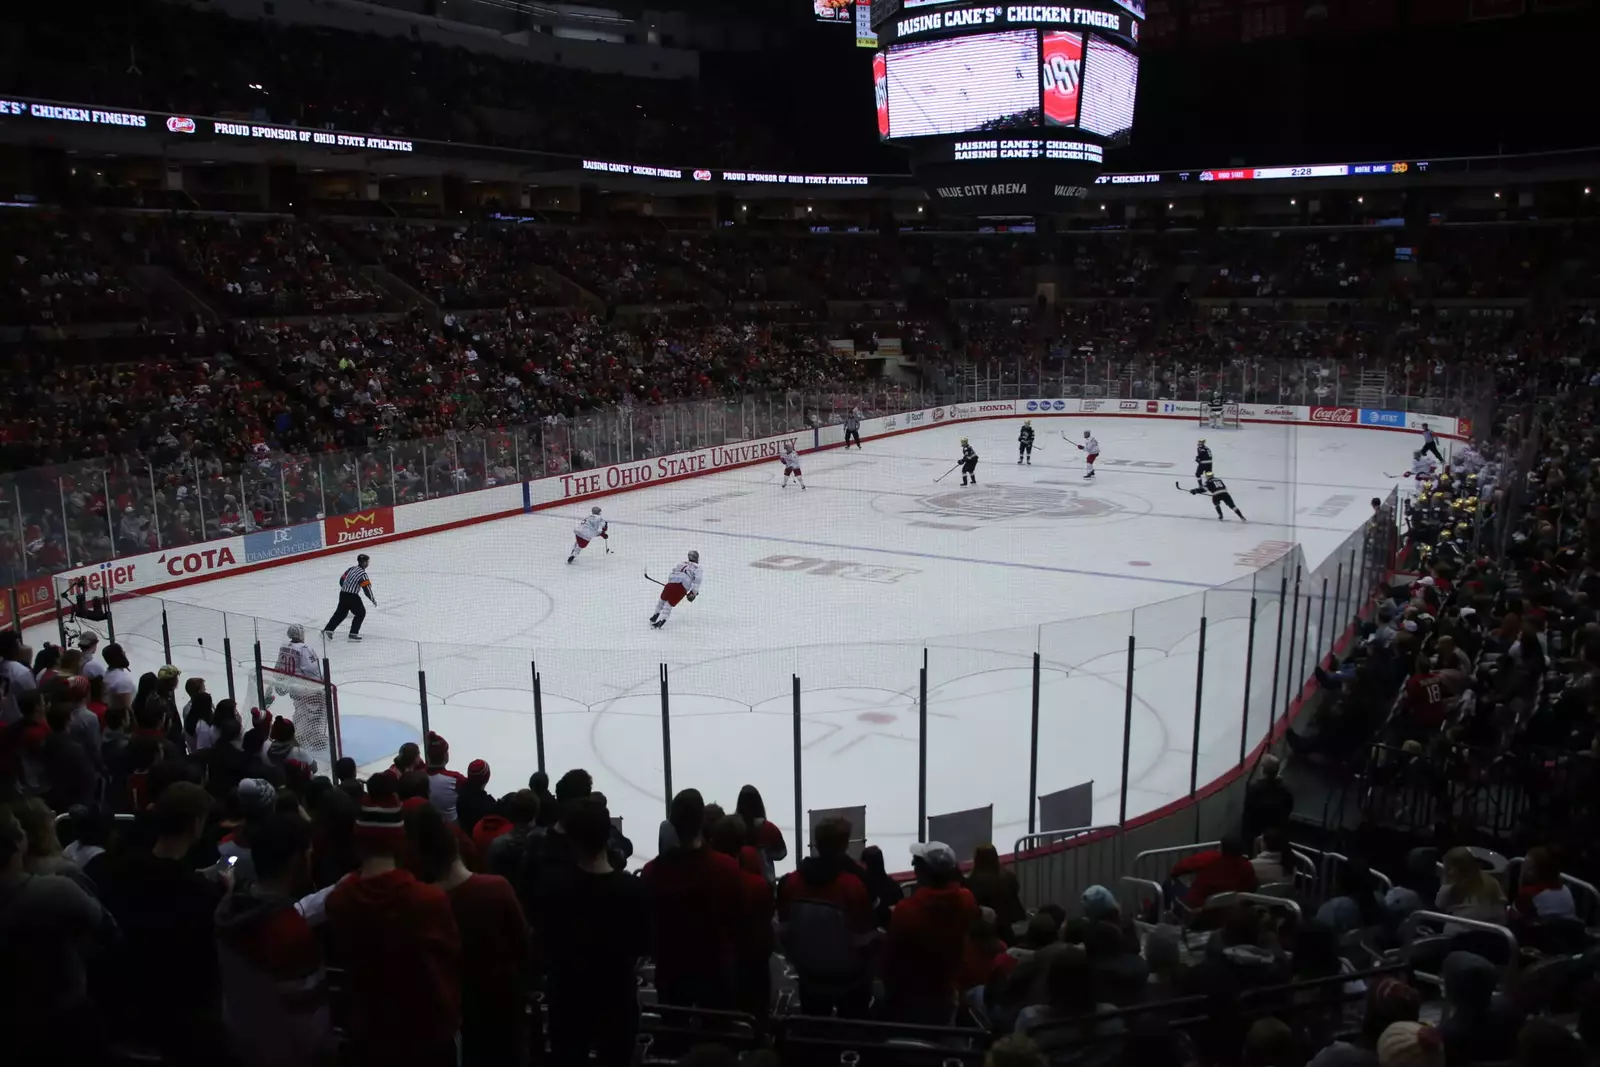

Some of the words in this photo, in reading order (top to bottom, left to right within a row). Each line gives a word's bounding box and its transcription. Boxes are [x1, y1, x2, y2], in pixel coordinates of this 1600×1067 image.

[897, 13, 941, 37] RAISING
[1006, 6, 1071, 23] CHICKEN
[1073, 10, 1120, 30] FINGERS
[31, 104, 90, 123] CHICKEN
[92, 110, 147, 127] FINGERS
[214, 122, 250, 136] PROUD
[252, 126, 298, 141] SPONSOR
[299, 132, 311, 142] OF
[313, 133, 336, 145] OHIO
[337, 135, 366, 147] STATE
[367, 138, 413, 151] ATHLETICS
[955, 141, 998, 150] RAISING
[1046, 141, 1084, 151] CHICKEN
[955, 150, 998, 160] RAISING
[1046, 150, 1084, 160] CHICKEN
[583, 160, 608, 171] RAISING
[1291, 168, 1312, 176] 2:28
[723, 172, 746, 181] PROUD
[747, 173, 778, 182] SPONSOR
[778, 175, 787, 183] OF
[788, 175, 804, 183] OHIO
[805, 176, 827, 184] STATE
[828, 177, 868, 185] ATHLETICS
[1112, 175, 1146, 184] CHICKEN
[1146, 174, 1160, 183] FIN
[936, 186, 964, 198] VALUE
[964, 184, 988, 196] CITY
[990, 183, 1027, 195] ARENA
[1054, 185, 1076, 196] VALUE
[979, 404, 1014, 412] HONDA
[1380, 413, 1399, 423] AT&T
[560, 475, 601, 498] THE
[606, 464, 652, 488] OHIO
[657, 457, 706, 478] STATE
[337, 526, 384, 543] Duchess
[246, 545, 290, 562] DIAMOND
[167, 547, 236, 576] COTA
[68, 562, 136, 595] meijer
[1427, 684, 1440, 703] 18
